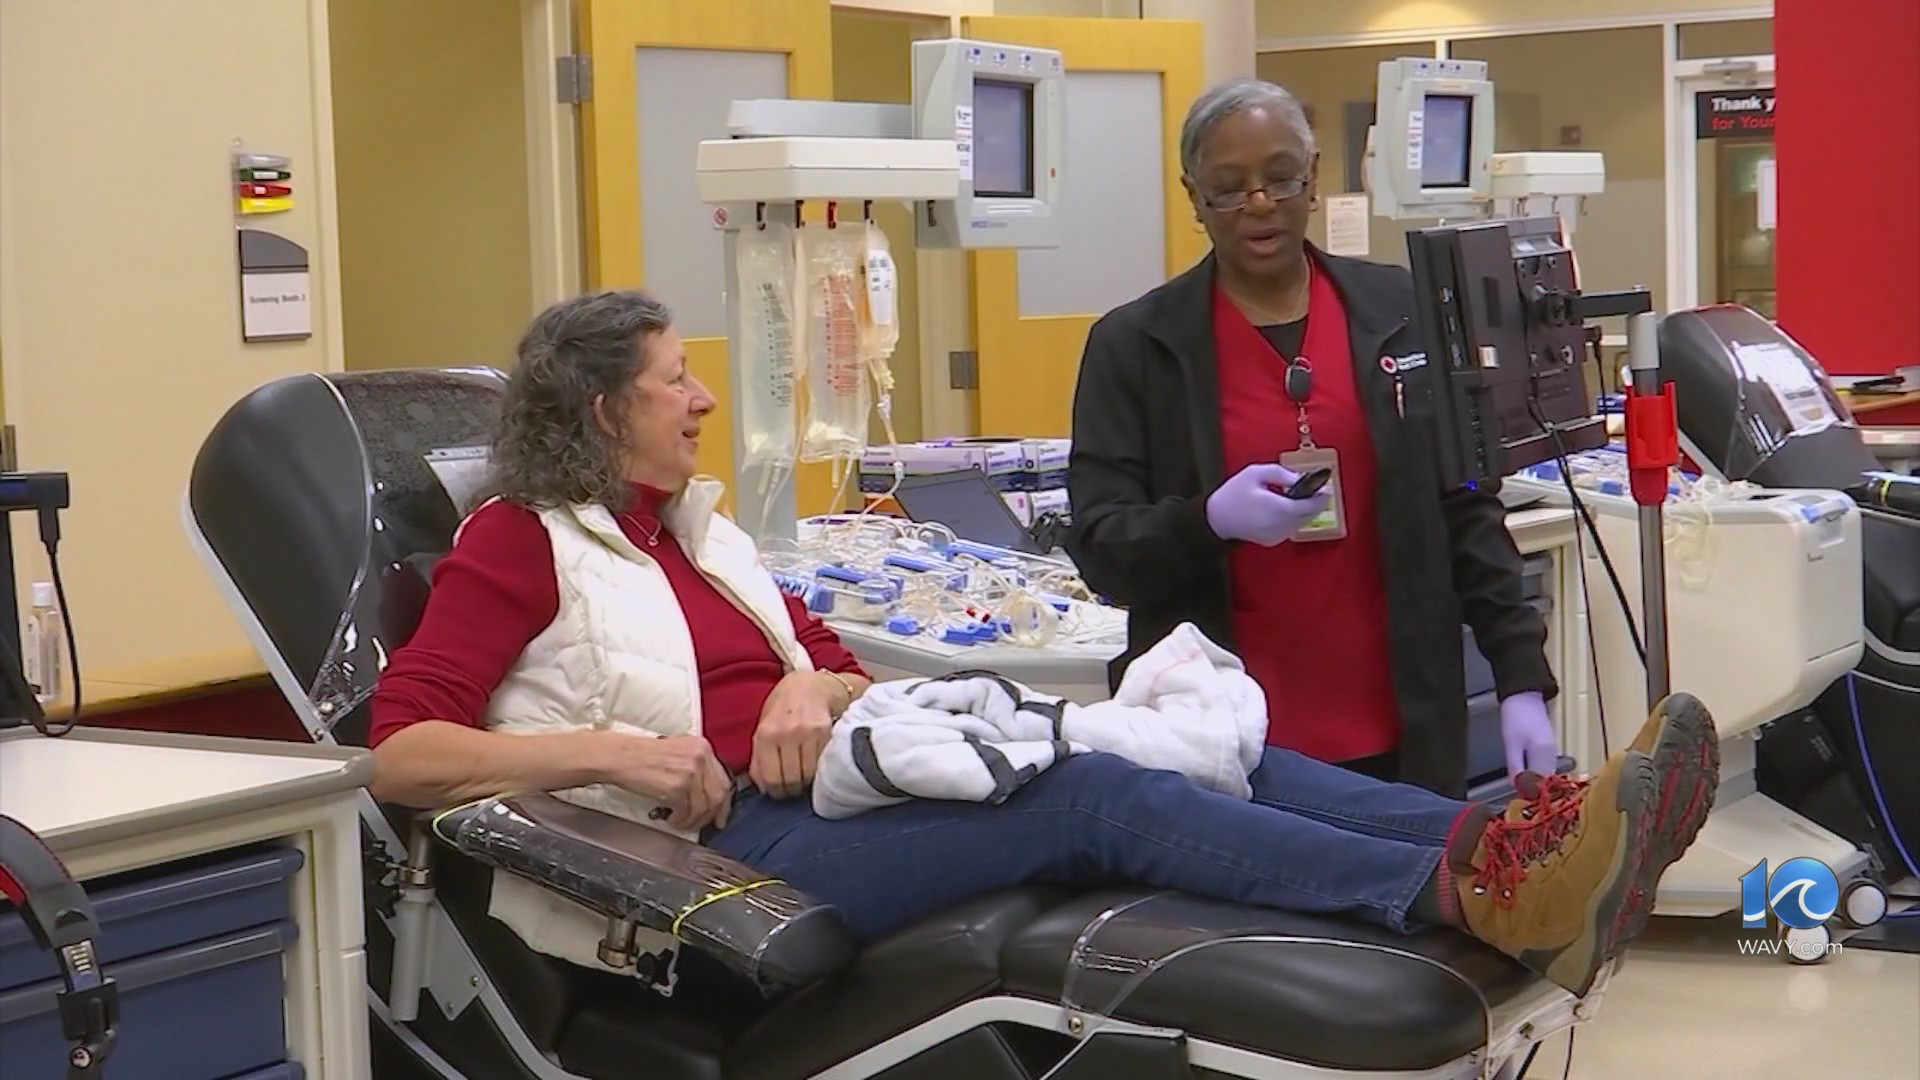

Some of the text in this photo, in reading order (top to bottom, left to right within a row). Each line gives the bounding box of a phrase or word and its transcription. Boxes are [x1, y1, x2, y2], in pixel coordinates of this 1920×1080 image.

[1711, 95, 1762, 112] Thank
[1712, 117, 1735, 130] for
[281, 293, 300, 302] Booth
